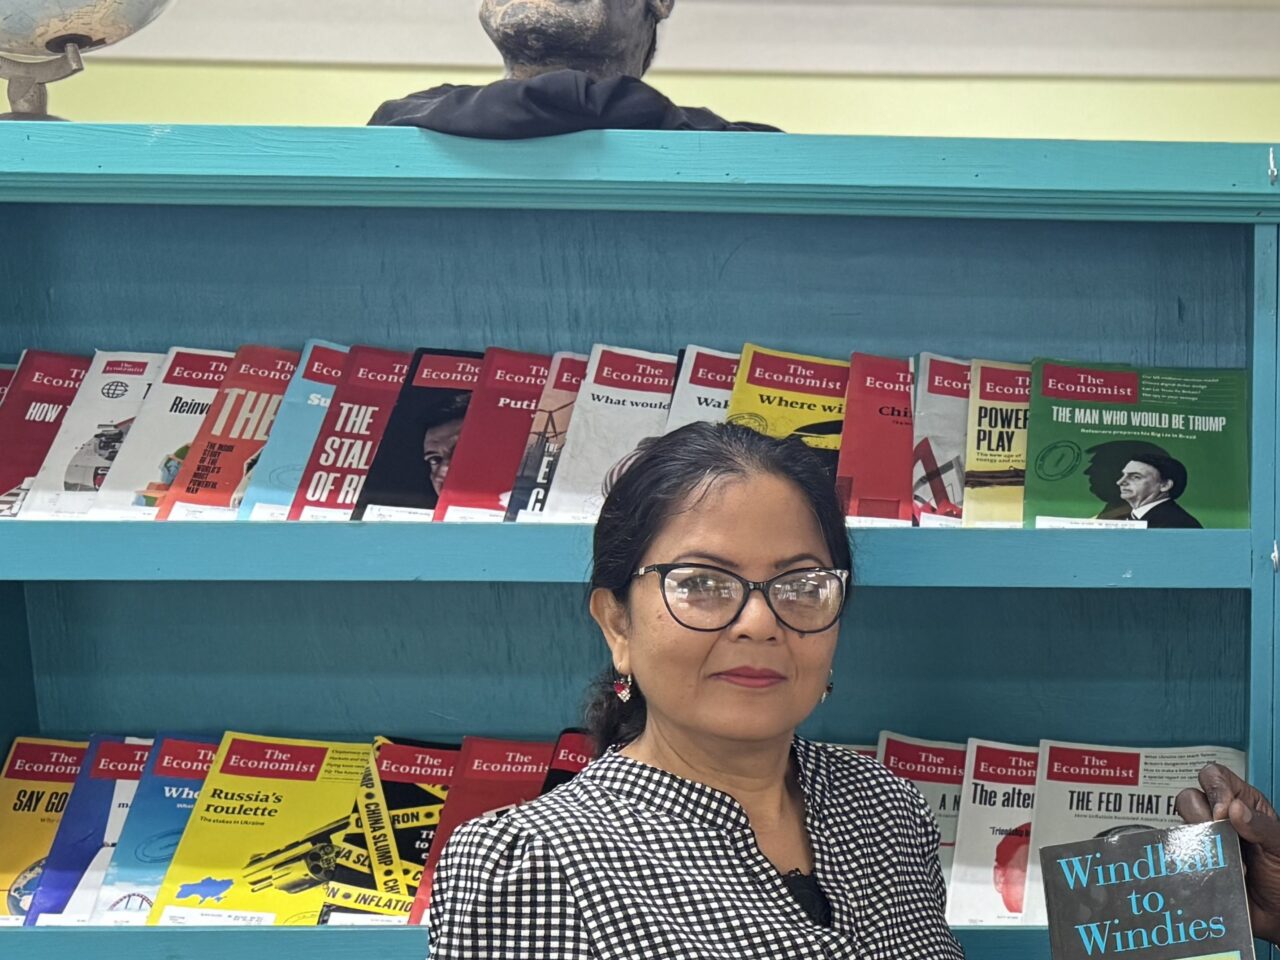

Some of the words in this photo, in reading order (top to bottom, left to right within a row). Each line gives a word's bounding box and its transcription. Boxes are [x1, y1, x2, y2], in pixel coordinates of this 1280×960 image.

[172, 366, 225, 382] Econo
[311, 361, 342, 378] Eco
[495, 370, 546, 386] Econo
[635, 363, 663, 375] The
[787, 363, 814, 376] The
[754, 367, 841, 391] Economist
[1047, 379, 1133, 396] Economist
[1077, 373, 1104, 386] The
[498, 397, 536, 410] Puti
[591, 393, 626, 407] What
[630, 400, 671, 411] would
[759, 393, 816, 413] Where
[25, 402, 63, 423] HOW
[211, 387, 284, 441] THE
[334, 402, 379, 435] THE
[1051, 405, 1072, 423] THE
[1074, 407, 1100, 425] MAN
[1102, 409, 1128, 426] WHO
[1131, 411, 1170, 429] WOULD
[1171, 414, 1186, 430] BE
[1188, 415, 1227, 433] TRUMP
[976, 429, 1015, 452] PLAY
[319, 436, 373, 469] STAL
[305, 471, 341, 502] OF
[50, 751, 77, 764] The
[264, 748, 291, 761] The
[415, 753, 442, 766] The
[505, 752, 532, 764] The
[919, 752, 944, 764] The
[1009, 756, 1035, 768] The
[1081, 755, 1108, 766] The
[229, 755, 317, 774] Economist
[1052, 761, 1134, 778] Economist
[13, 789, 45, 812] SAY
[45, 791, 69, 813] GO
[210, 788, 284, 804] Russia's
[939, 793, 946, 811] A
[971, 782, 997, 806] The
[1068, 790, 1093, 811] THE
[1097, 792, 1122, 812] FED
[1128, 793, 1162, 814] THAT
[204, 803, 279, 818] roulette
[364, 802, 382, 833] CHINA
[372, 833, 394, 866] SLUMP
[1056, 834, 1228, 891] Windball
[1127, 888, 1165, 916] to
[1074, 909, 1227, 956] Windies
